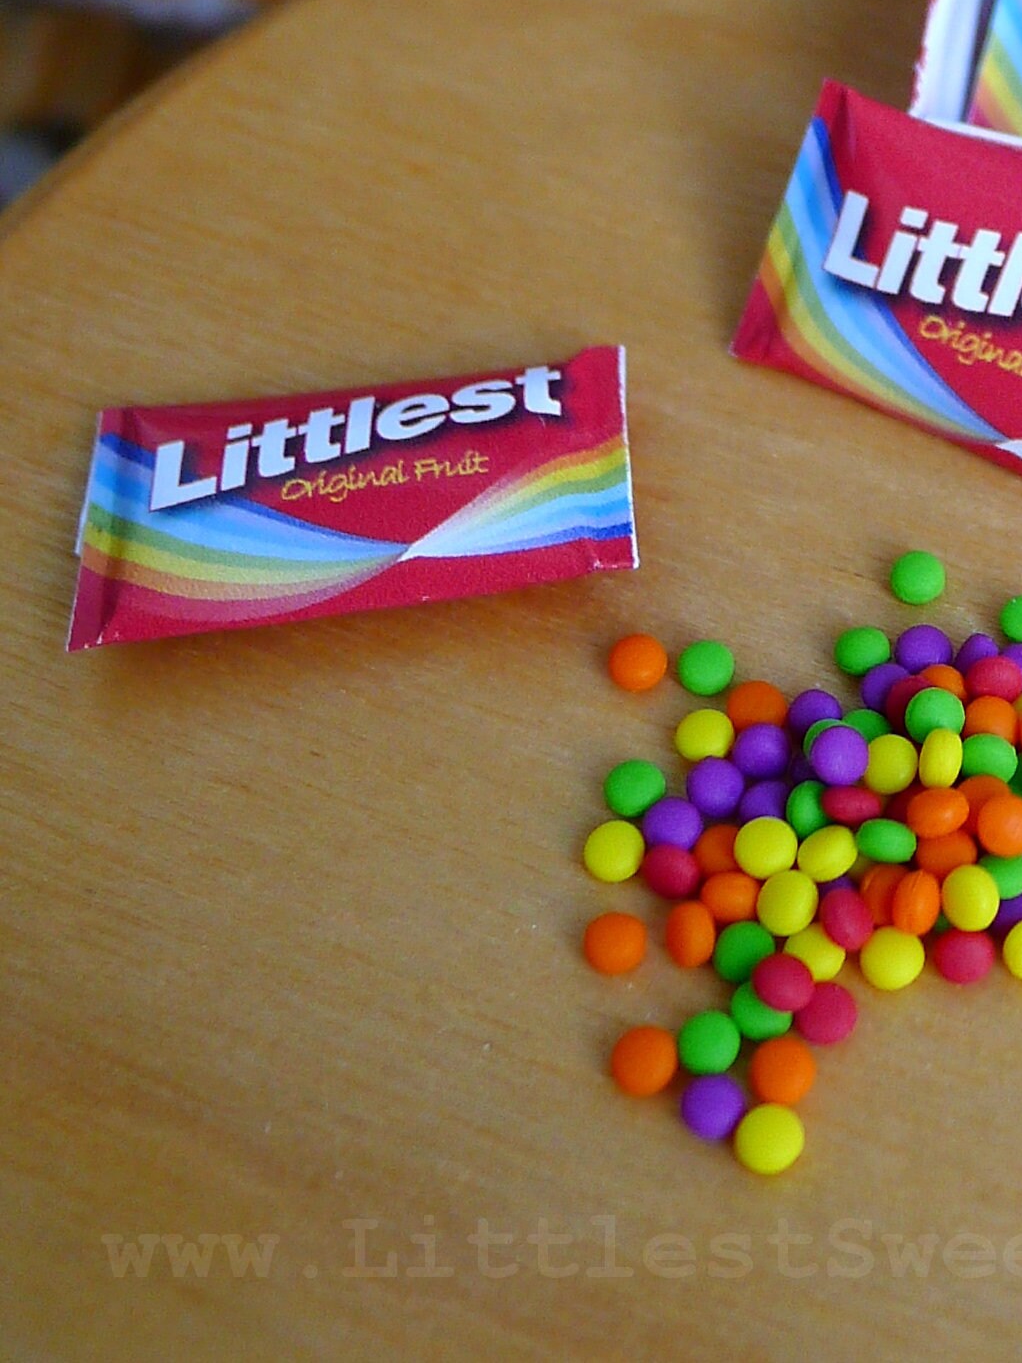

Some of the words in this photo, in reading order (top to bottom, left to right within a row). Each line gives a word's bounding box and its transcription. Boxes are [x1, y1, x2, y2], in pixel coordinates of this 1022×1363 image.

[148, 365, 562, 513] Littlest
[281, 459, 410, 503] Original
[414, 449, 490, 482] Fruit
